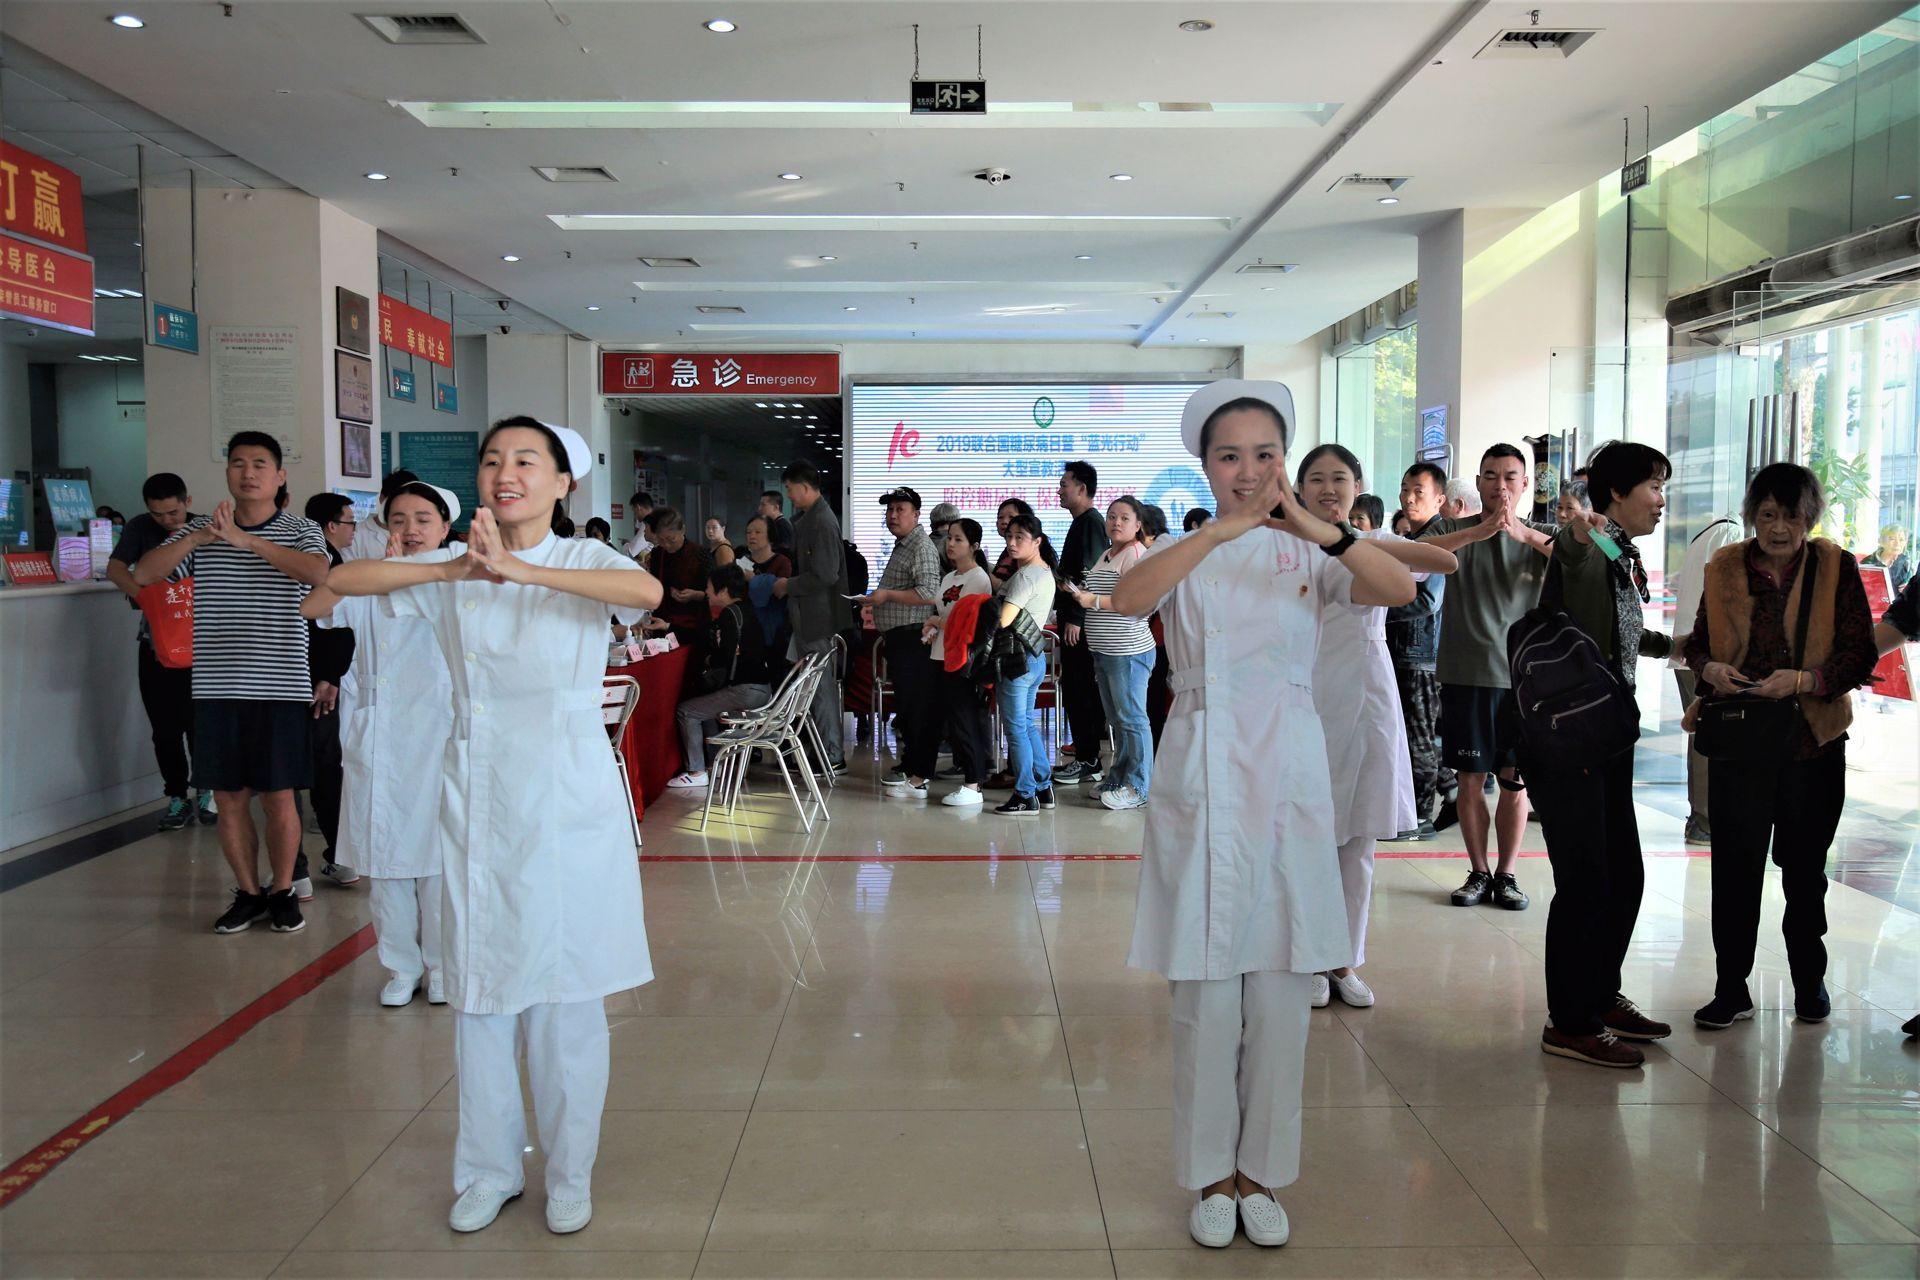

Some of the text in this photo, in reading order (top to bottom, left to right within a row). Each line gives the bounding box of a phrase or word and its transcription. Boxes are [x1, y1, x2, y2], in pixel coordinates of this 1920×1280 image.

[1628, 178, 1640, 189] EXIT
[0, 247, 56, 284] 导医台
[160, 317, 166, 335] 1
[406, 327, 445, 362] 奉献社会
[671, 358, 742, 388] 急诊
[746, 373, 817, 386] Emergency
[1003, 460, 1066, 478] 大型宣教活
